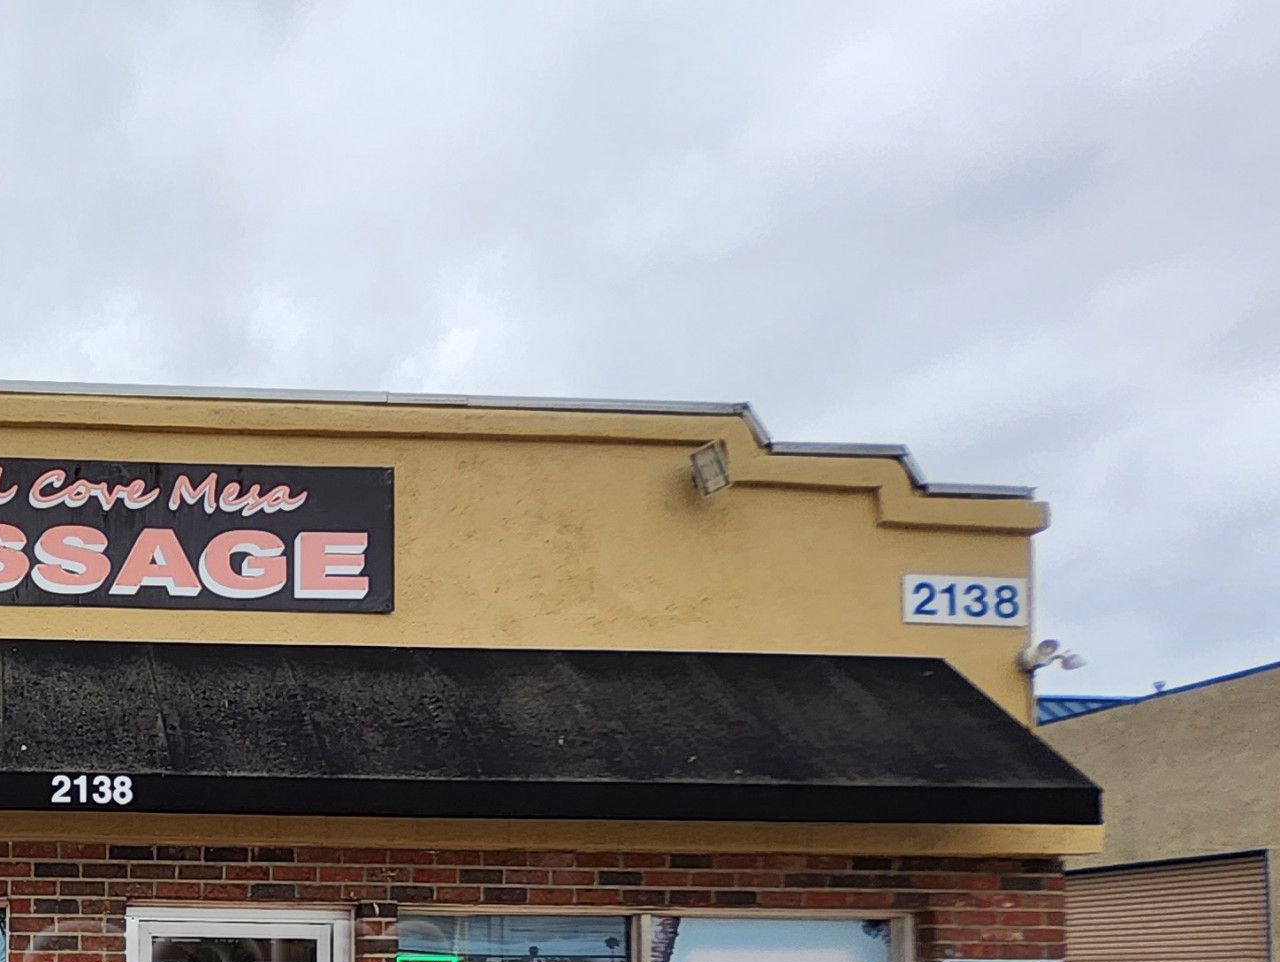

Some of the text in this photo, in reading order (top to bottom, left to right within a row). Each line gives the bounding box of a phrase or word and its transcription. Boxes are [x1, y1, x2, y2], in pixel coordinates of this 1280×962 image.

[29, 469, 160, 512] Cove
[167, 473, 308, 516] Mesa
[912, 582, 1019, 619] 2138
[51, 775, 133, 805] 2138
